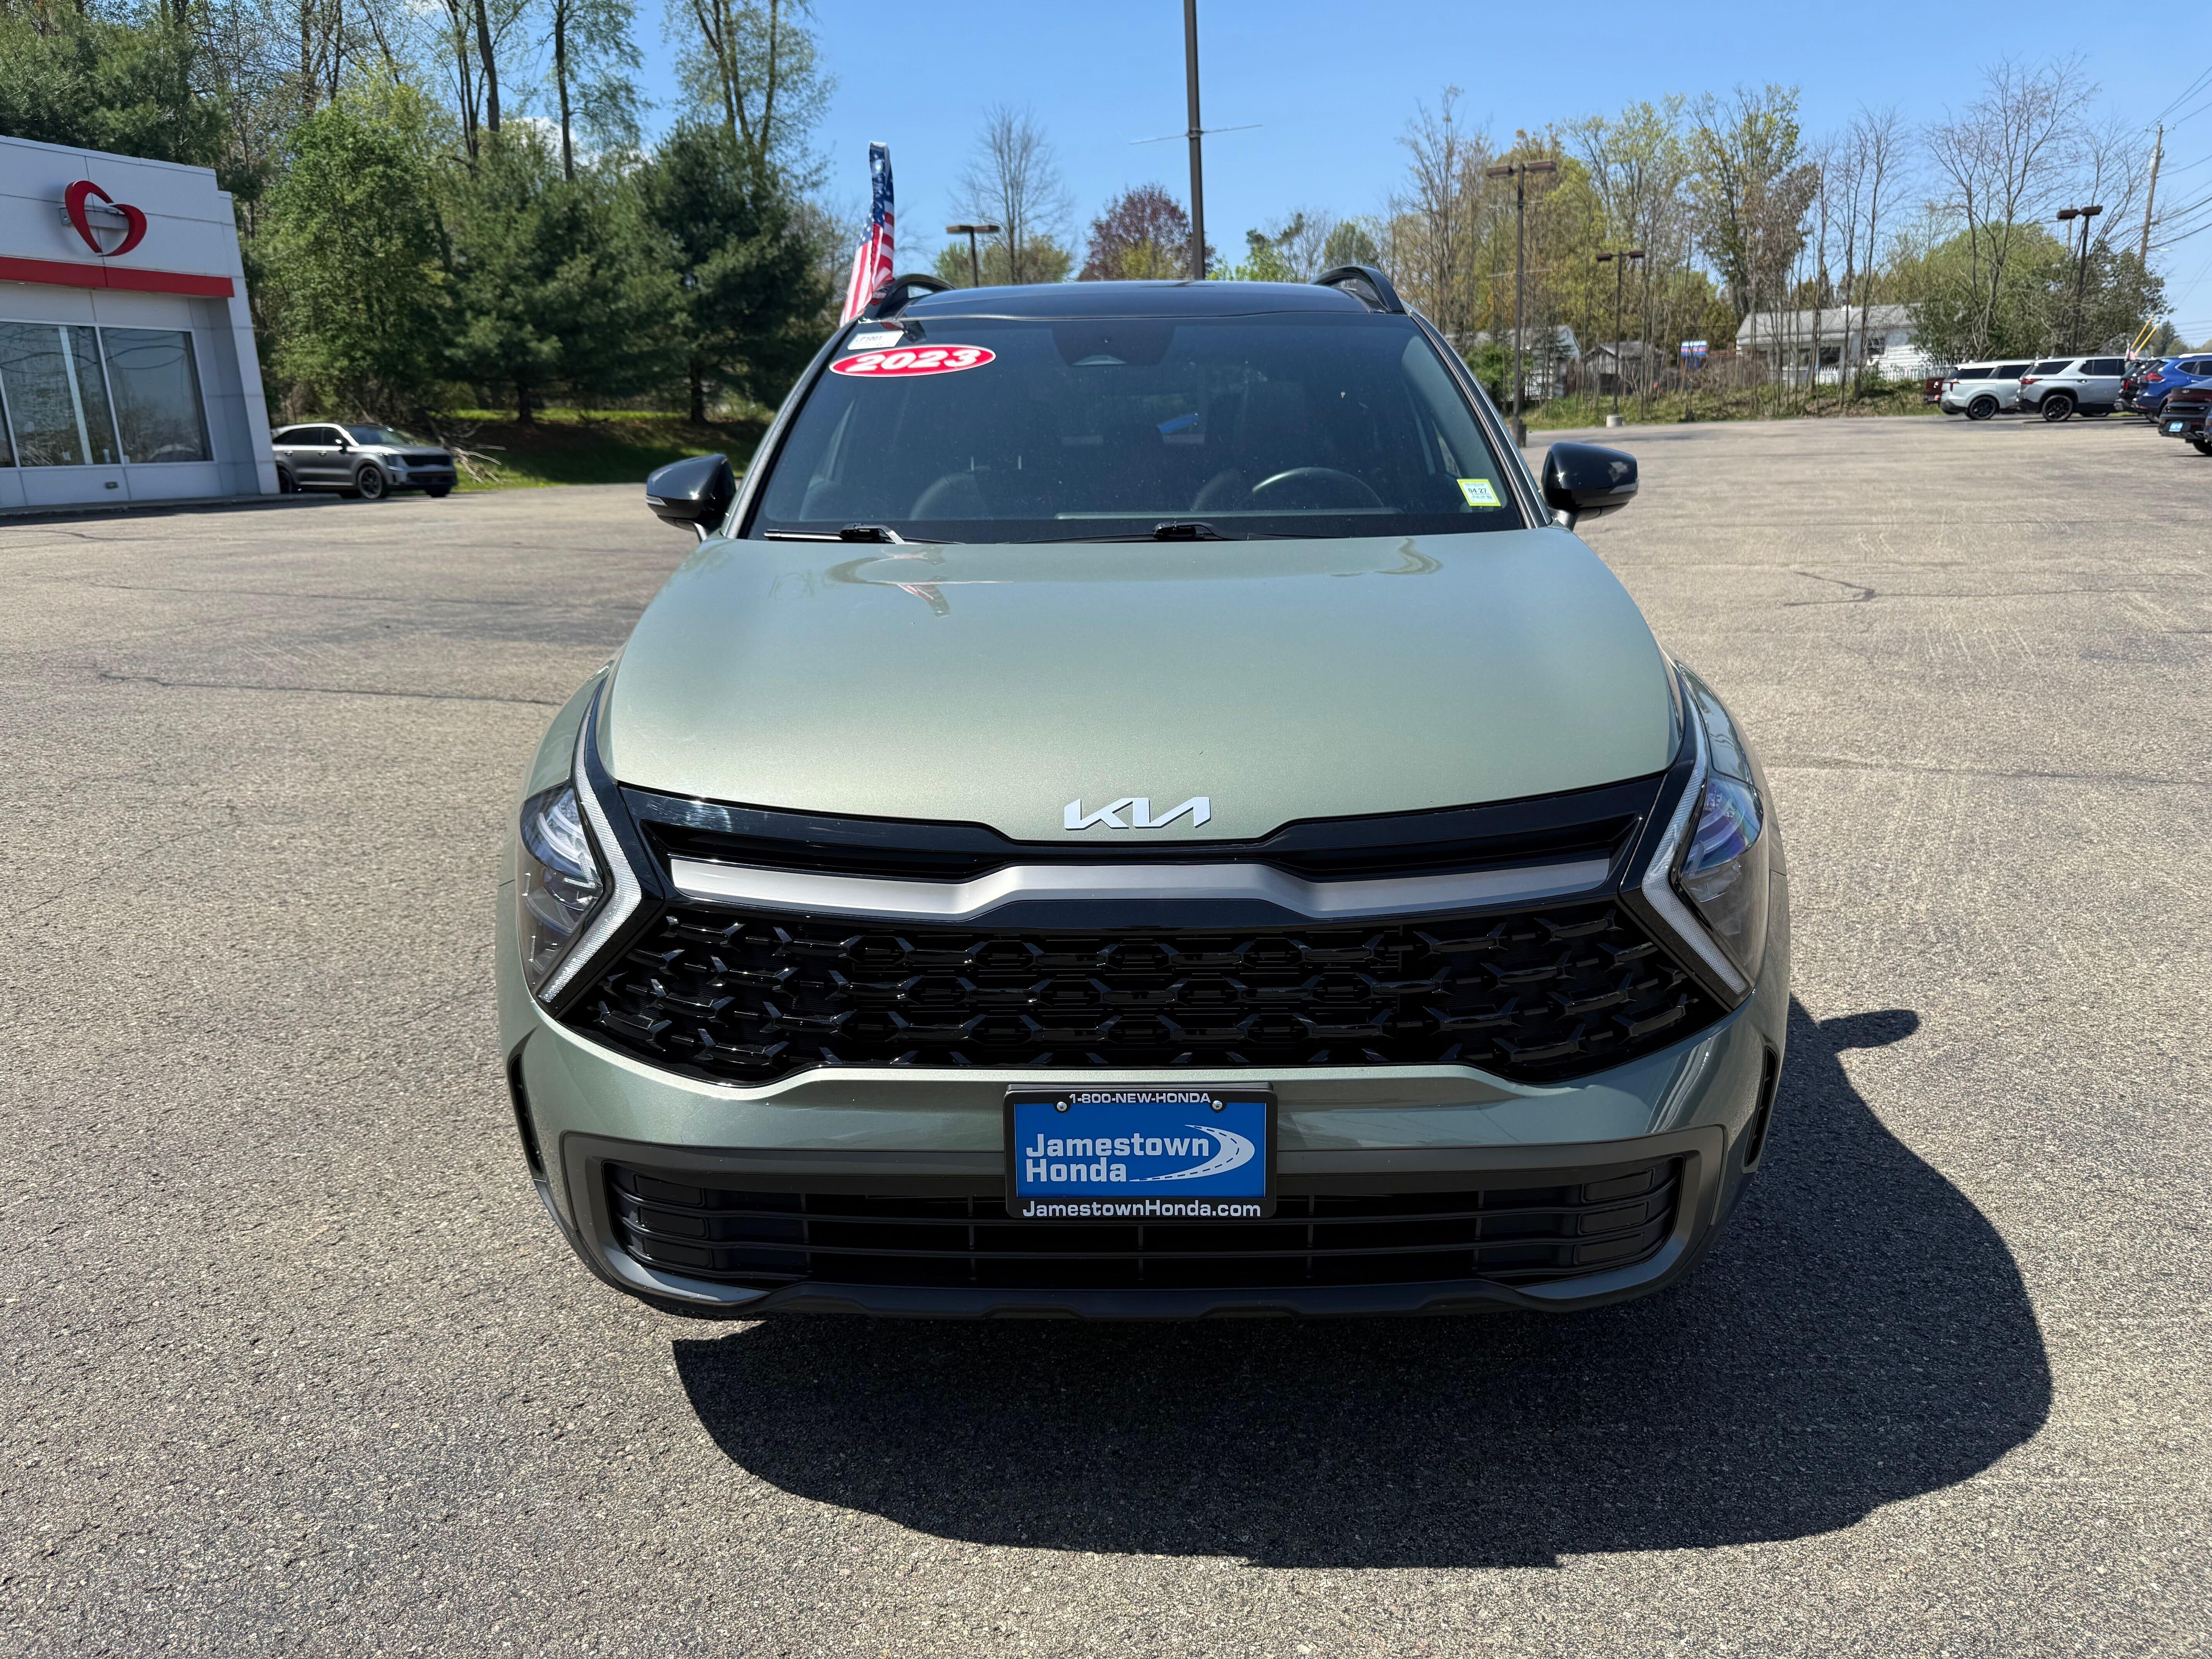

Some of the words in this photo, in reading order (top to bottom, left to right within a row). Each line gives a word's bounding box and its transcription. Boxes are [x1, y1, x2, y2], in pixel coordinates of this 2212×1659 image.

[845, 349, 981, 372] 2023
[1064, 797, 1211, 830] KIA
[1069, 1093, 1211, 1104] 1-800-NEW-HONDA
[1026, 1133, 1209, 1157] Jamestown
[1026, 1157, 1127, 1182] Honda
[1023, 1200, 1261, 1217] JamestownHonda.com
